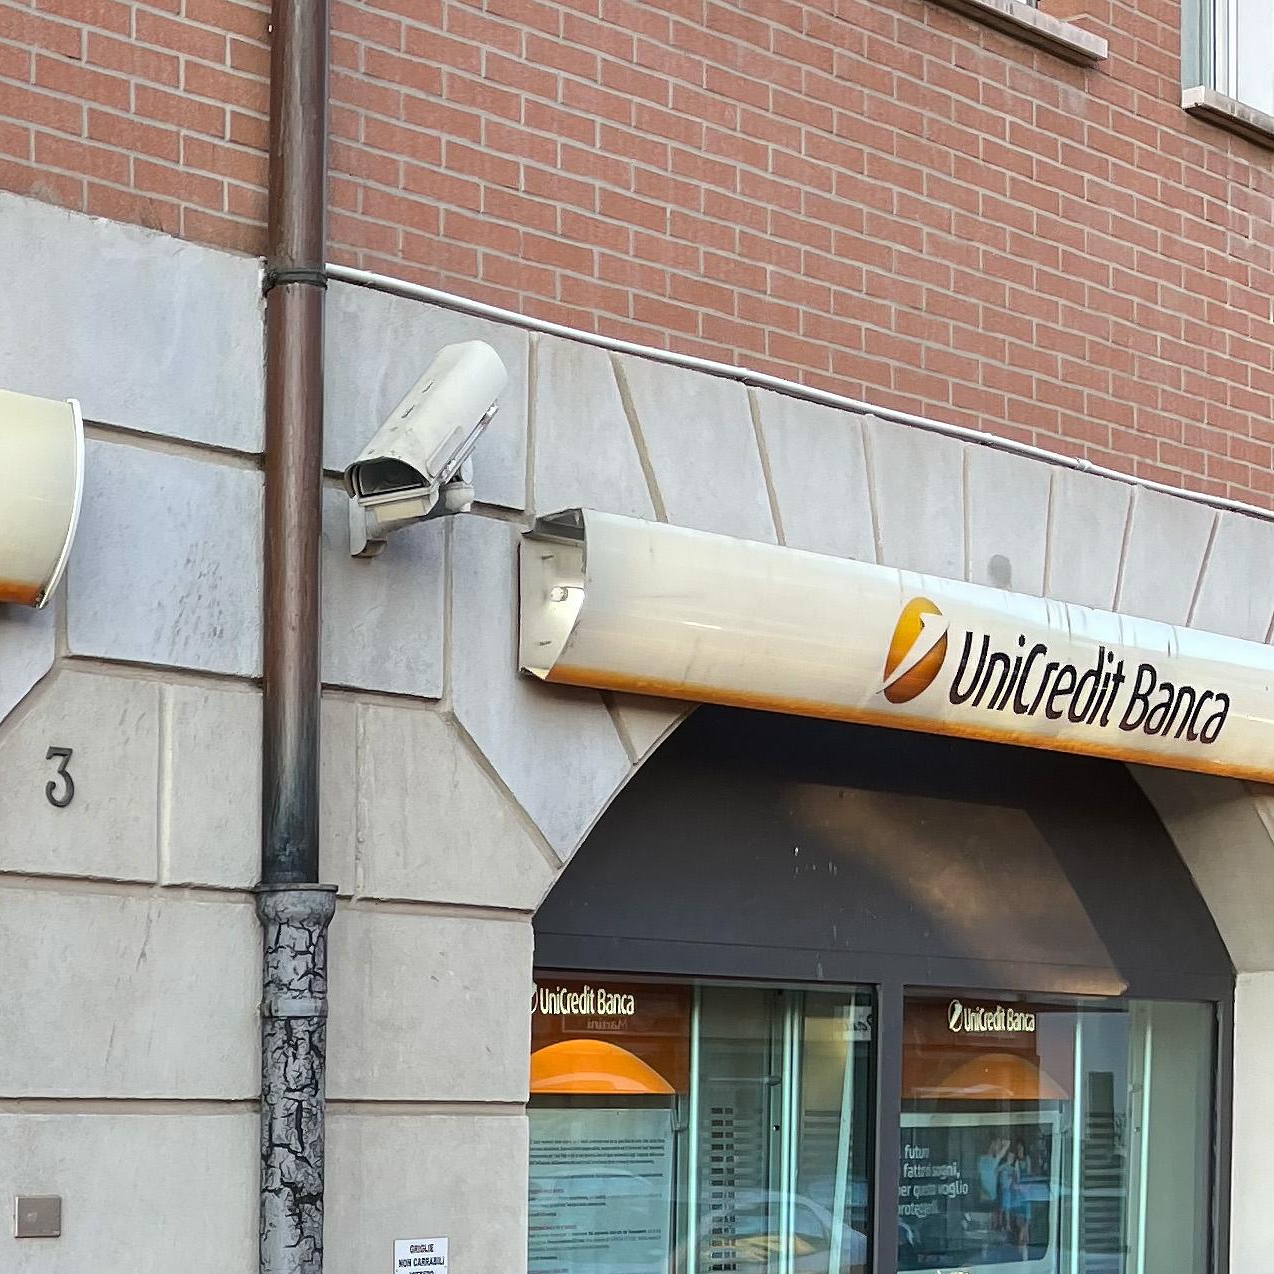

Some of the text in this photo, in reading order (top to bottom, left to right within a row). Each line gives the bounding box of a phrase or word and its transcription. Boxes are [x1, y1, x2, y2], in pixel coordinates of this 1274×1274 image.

[949, 629, 1231, 746] UniCredit Banca
[45, 745, 75, 808] 3
[539, 984, 635, 1015] UniCredit Banca
[963, 1004, 1036, 1032] UniCredit Banca
